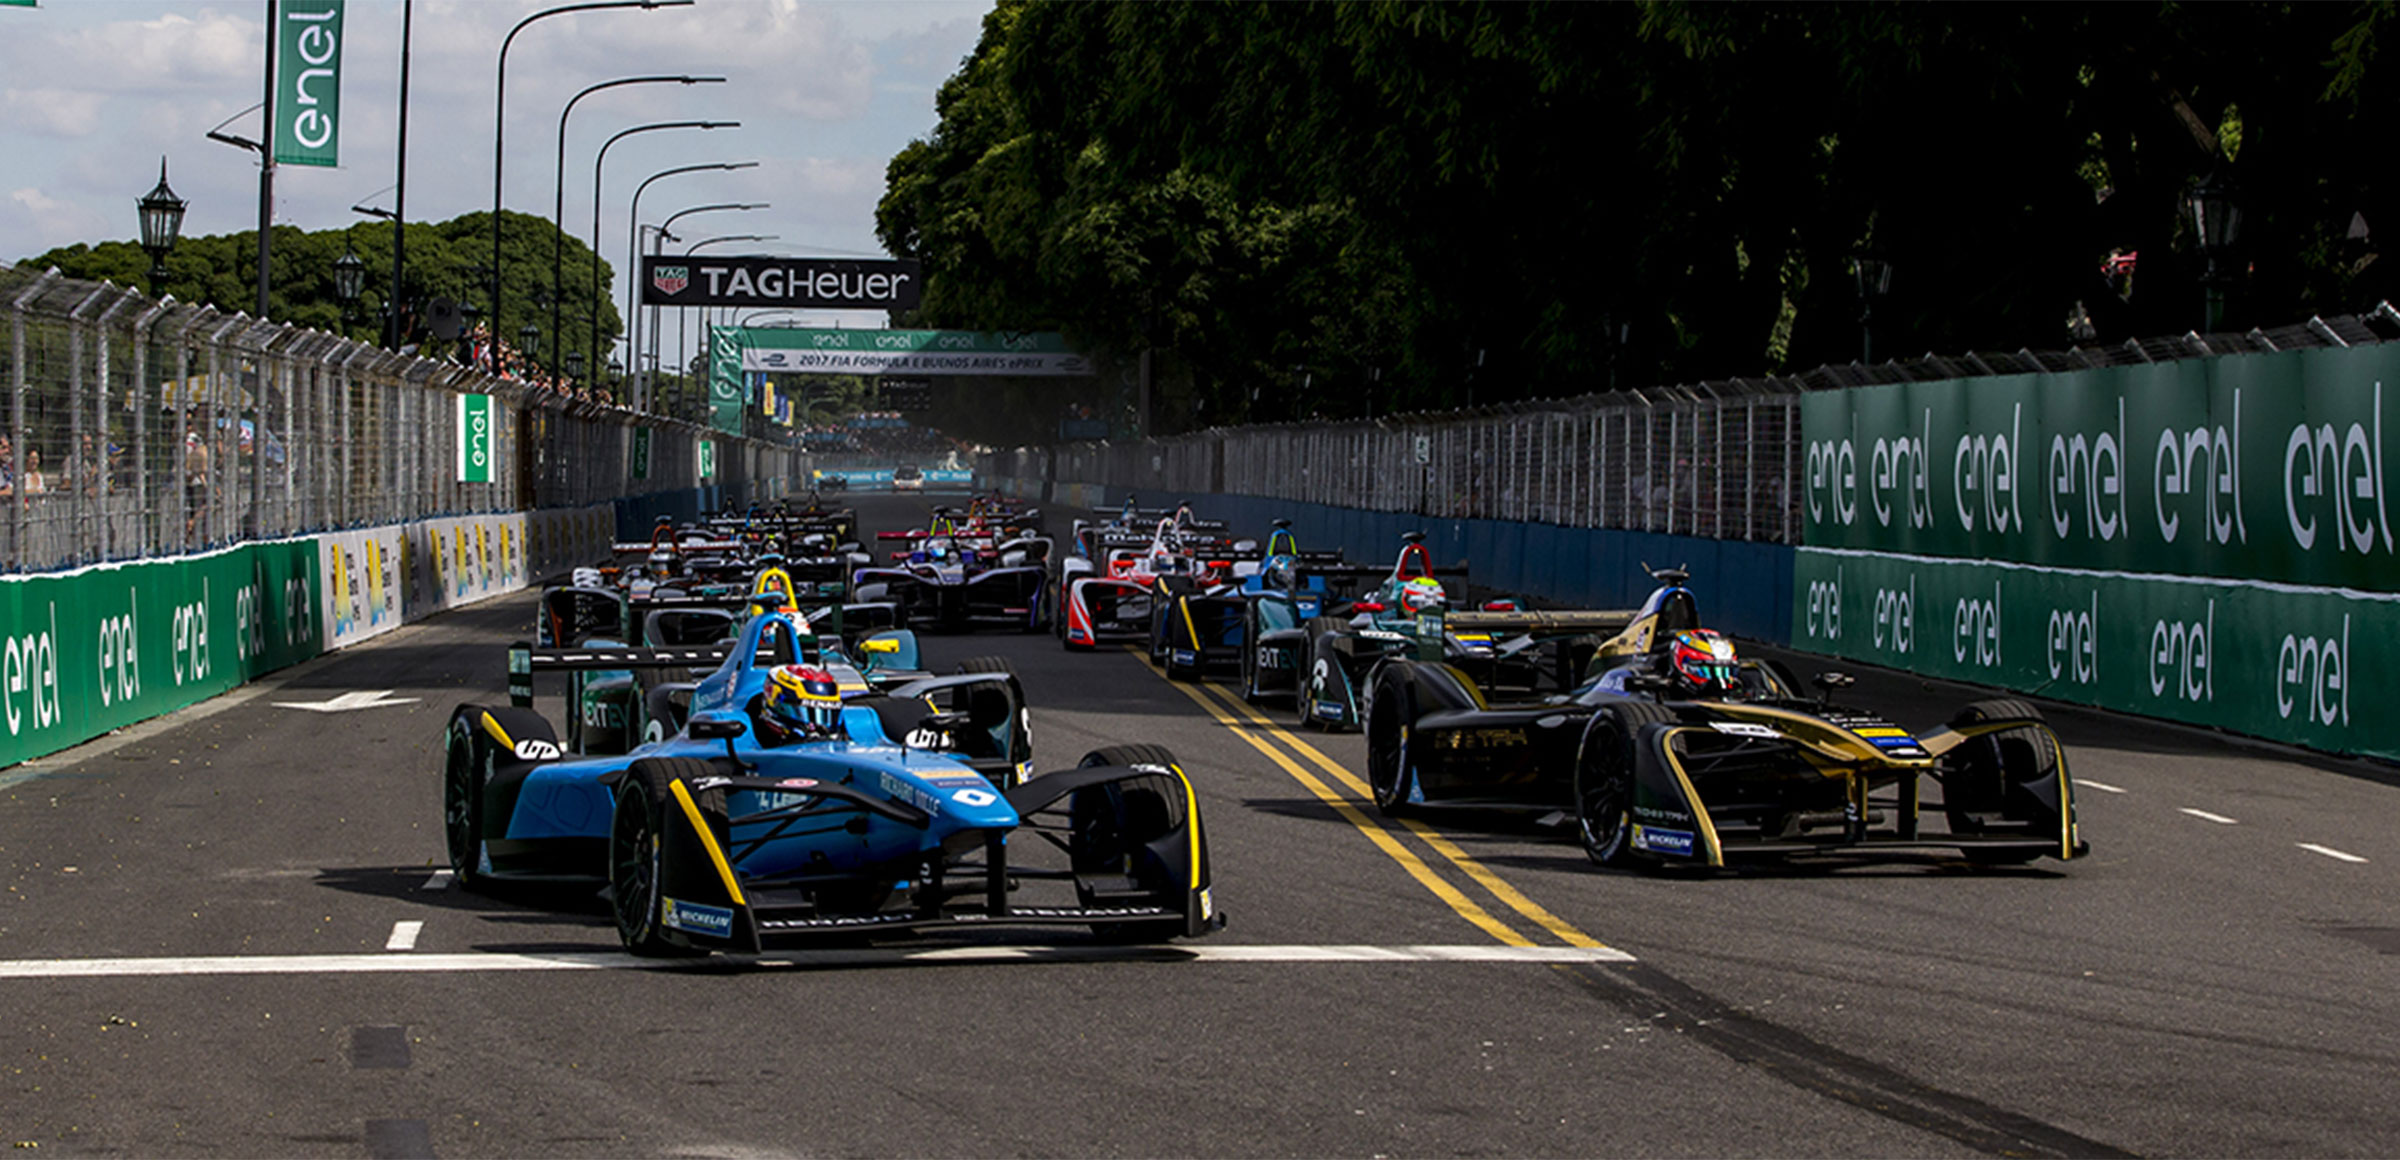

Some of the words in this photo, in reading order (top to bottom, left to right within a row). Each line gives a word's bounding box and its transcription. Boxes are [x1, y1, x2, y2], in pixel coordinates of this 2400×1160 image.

[288, 9, 336, 148] enel
[800, 354, 828, 366] 2017
[831, 355, 851, 366] FIA
[852, 355, 908, 368] FORMULA
[912, 357, 920, 368] E
[922, 357, 969, 369] BUENOS
[971, 357, 1007, 369] AIRES
[1009, 358, 1044, 369] ePRIX
[813, 334, 849, 347] enel
[876, 334, 912, 348] enel
[939, 335, 974, 348] enel
[469, 409, 486, 466] enel
[1807, 411, 1857, 526] enel
[1871, 408, 1934, 529] enel
[1954, 402, 2022, 533] enel
[2050, 396, 2128, 542] enel
[2155, 388, 2246, 545] enel
[2285, 381, 2394, 555] enel
[100, 586, 140, 707] enel
[172, 576, 210, 686] enel
[236, 560, 265, 662] enel
[285, 555, 313, 646] enel
[1807, 565, 1842, 639] enel
[1873, 573, 1915, 653] enel
[1954, 581, 2001, 667] enel
[2048, 590, 2098, 684] enel
[2150, 599, 2214, 702] enel
[4, 601, 60, 736] enel
[2278, 613, 2350, 727] enel
[1648, 833, 1692, 847] MICHELIN
[679, 909, 729, 928] MICHELIN
